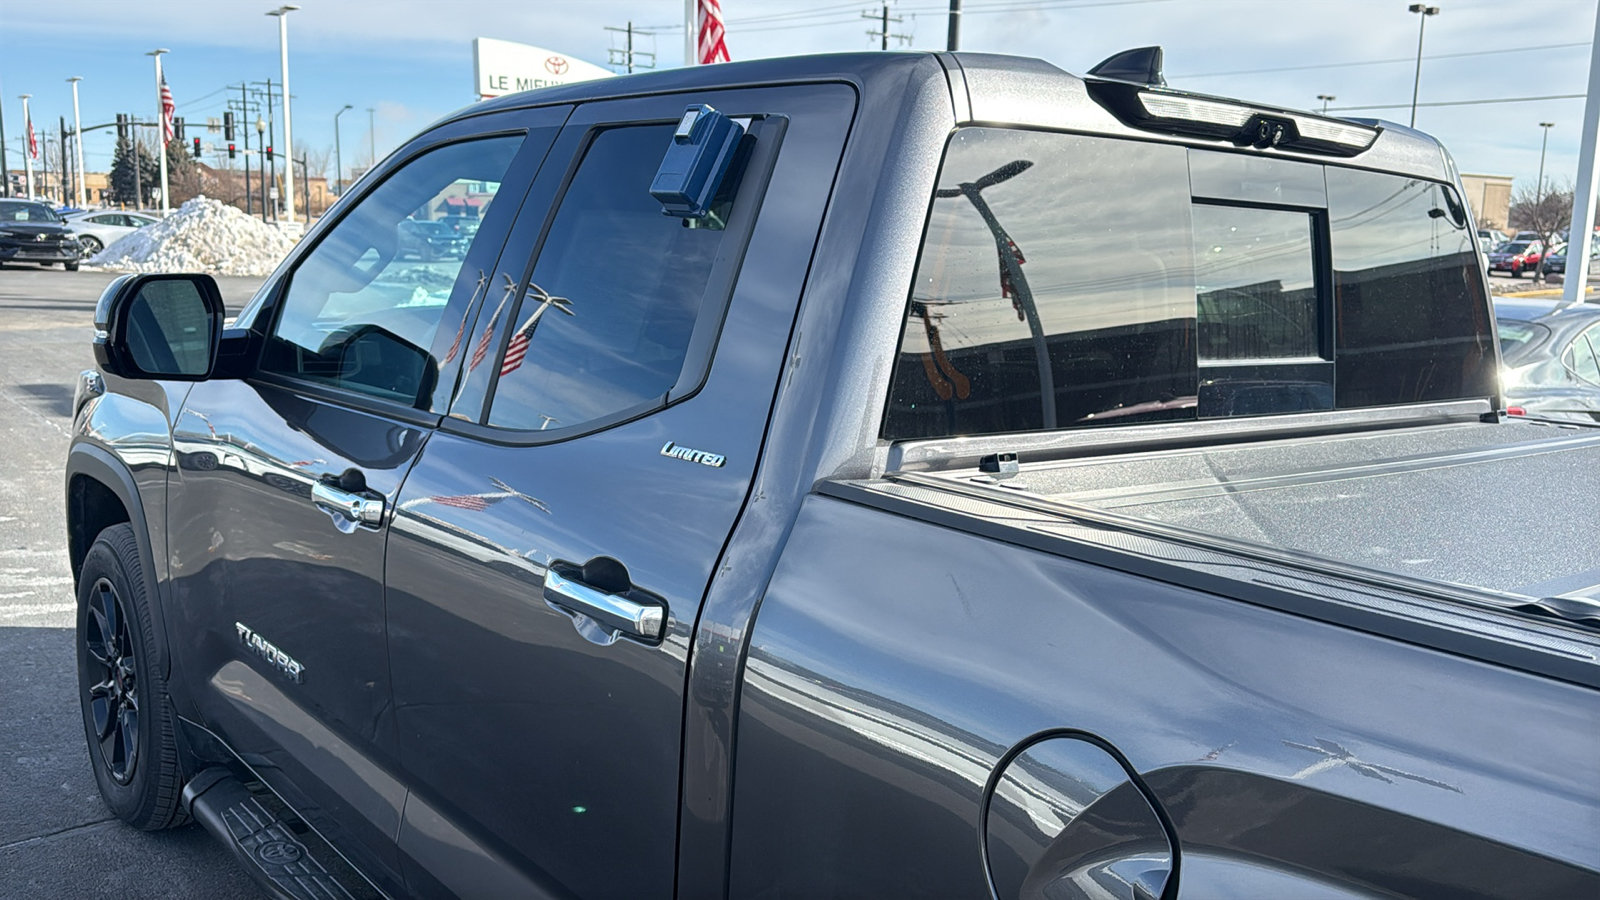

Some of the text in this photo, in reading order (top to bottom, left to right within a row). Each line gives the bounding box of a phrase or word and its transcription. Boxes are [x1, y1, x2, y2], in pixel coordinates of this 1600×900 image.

[489, 75, 564, 91] LE MIE
[660, 440, 726, 468] LIMITED
[235, 621, 305, 684] TUNDRA
